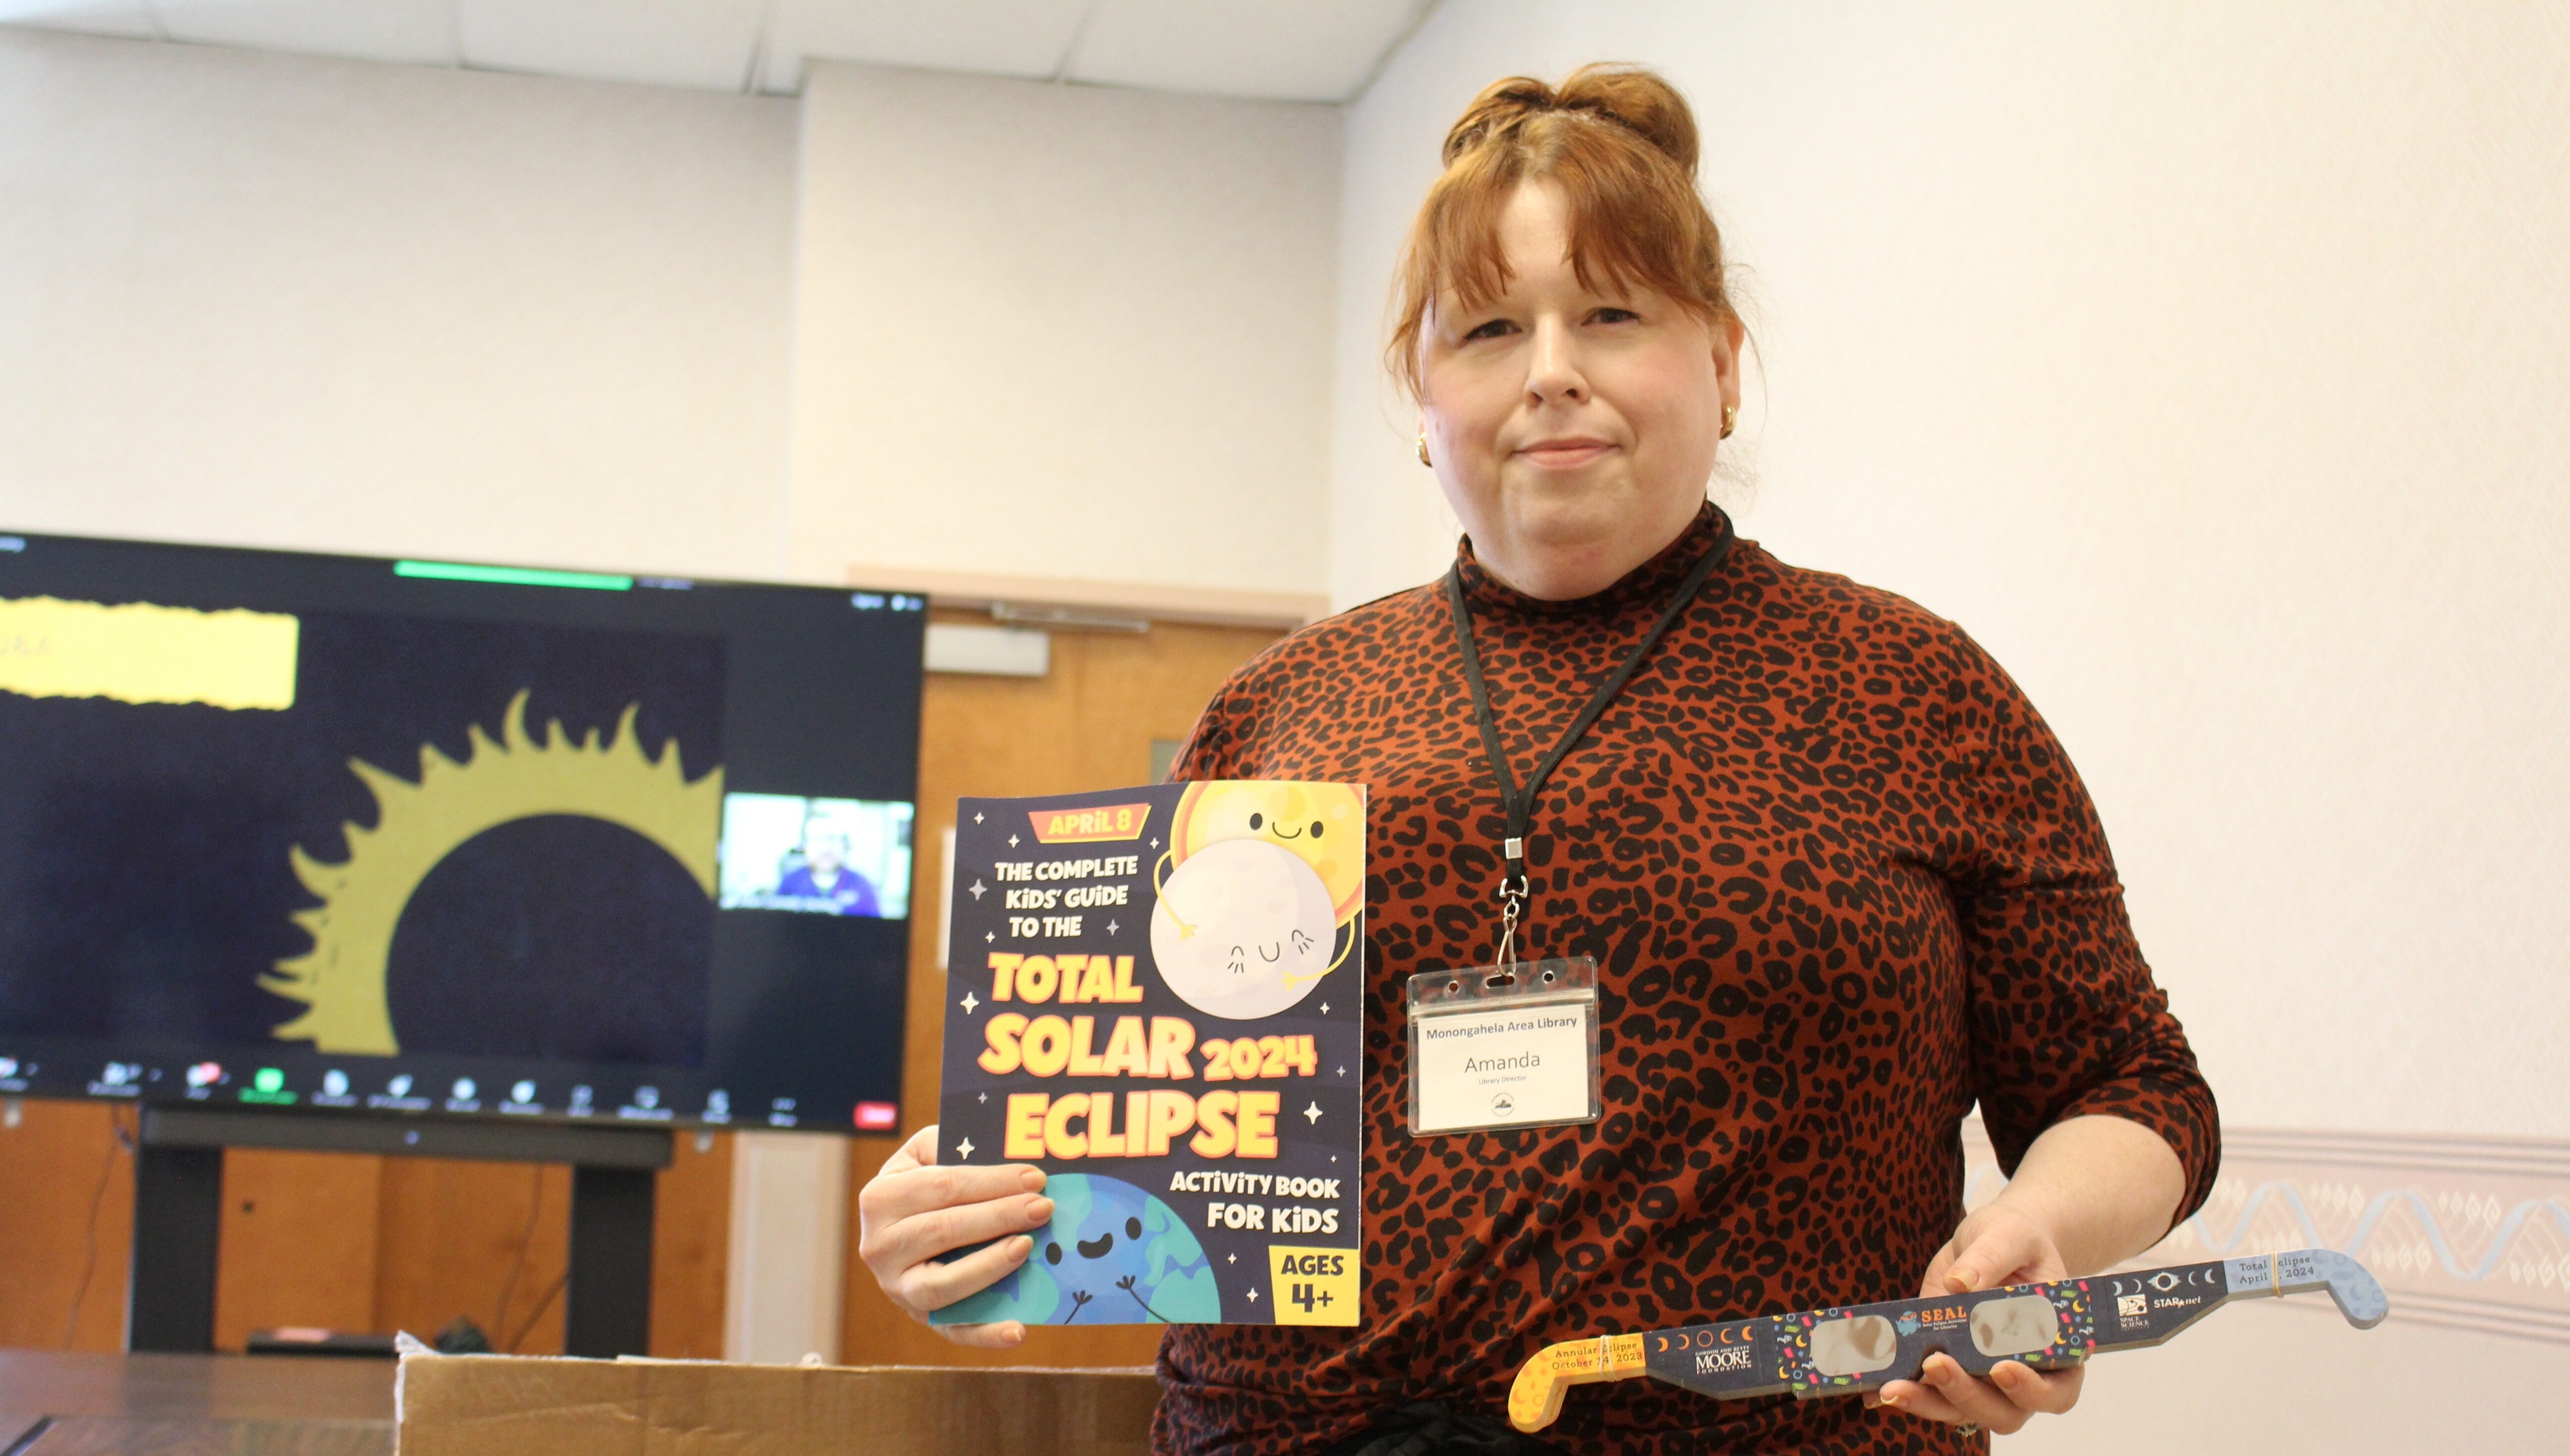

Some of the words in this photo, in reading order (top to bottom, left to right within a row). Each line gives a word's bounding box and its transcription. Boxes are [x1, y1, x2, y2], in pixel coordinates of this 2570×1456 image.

[1116, 809, 1132, 831] 8
[994, 862, 1034, 881] THE
[1035, 855, 1139, 881] COMPLETE
[1009, 917, 1040, 938] TO
[1043, 916, 1083, 937] THE
[988, 952, 1144, 1004] TOTAL
[1426, 1023, 1504, 1040] Monongahela
[1507, 1022, 1534, 1032] Area
[1537, 1017, 1577, 1029] Library
[977, 1012, 1196, 1080] SOLAR
[1200, 1034, 1318, 1082] 2024
[1464, 1051, 1540, 1073] Amanda
[1004, 1089, 1280, 1160] ECLIPSE
[1275, 1176, 1341, 1199] BOOK
[1207, 1202, 1264, 1230] FOR
[1281, 1255, 1344, 1276] AGES
[2239, 1260, 2267, 1271] Total
[2275, 1257, 2310, 1267] clipse
[2240, 1273, 2268, 1284] April
[2286, 1267, 2314, 1278] 2024
[1291, 1283, 1334, 1313] 4+
[1922, 1305, 1968, 1323] SEAL
[1552, 1359, 1592, 1370] October
[1616, 1352, 1642, 1362] 2023
[1555, 1347, 1597, 1358] Annular
[1696, 1350, 1751, 1370] MOORE
[1696, 1364, 1752, 1375] FOUNDATION
